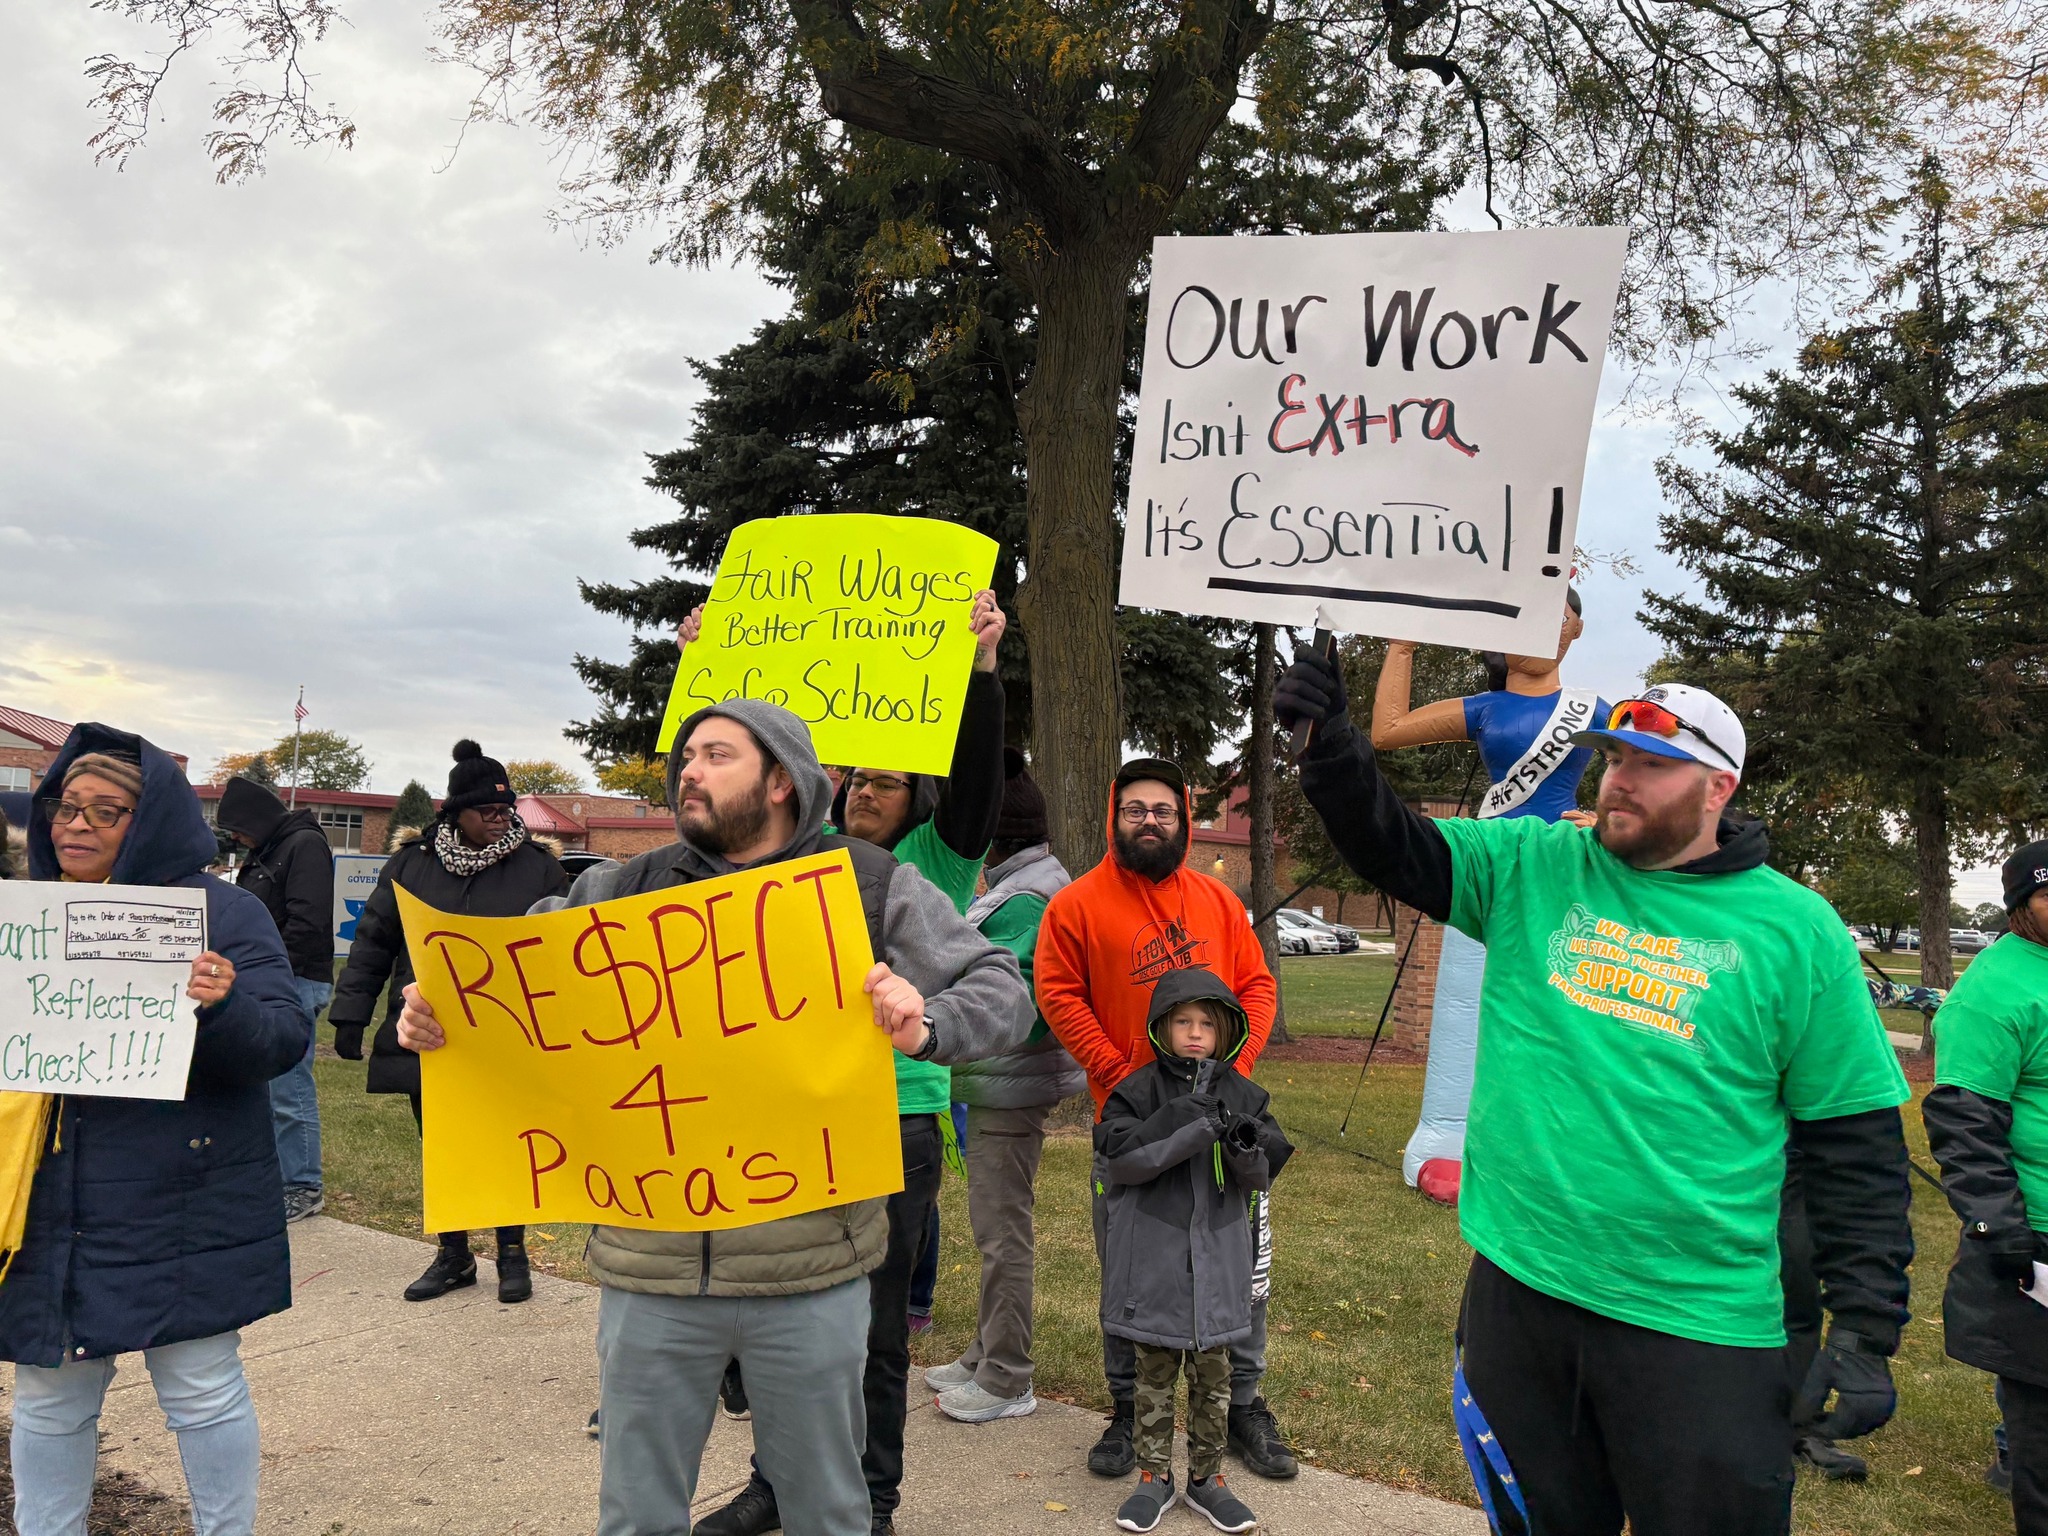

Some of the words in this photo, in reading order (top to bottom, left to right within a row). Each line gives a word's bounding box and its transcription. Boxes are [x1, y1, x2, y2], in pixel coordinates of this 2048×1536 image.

[1165, 284, 1328, 369] Our
[1363, 282, 1589, 371] Work
[1268, 373, 1480, 458] Extra
[1145, 496, 1203, 558] It's
[839, 547, 973, 617] Wages
[720, 611, 819, 649] Better
[818, 606, 946, 661] Training
[801, 658, 943, 725] Schools
[347, 875, 378, 884] GOVER
[2034, 868, 2048, 883] SE
[0, 908, 58, 962] ant
[87, 913, 97, 921] the
[101, 911, 116, 921] Order
[118, 912, 125, 921] of
[1595, 919, 1630, 944] WE
[1628, 932, 1685, 961] CARE,
[423, 864, 844, 1052] RE$PECT
[1570, 937, 1588, 954] WE
[1588, 939, 1631, 963] STAND
[1631, 953, 1711, 990] TOGETHER,
[1571, 960, 1688, 1011] SUPPORT
[27, 973, 179, 1022] Reflected
[1548, 972, 1697, 1040] PARAPROFESSIONALS
[3, 1030, 165, 1084] Check!!!!
[609, 1063, 709, 1157] 4
[517, 1127, 838, 1220] Para's!
